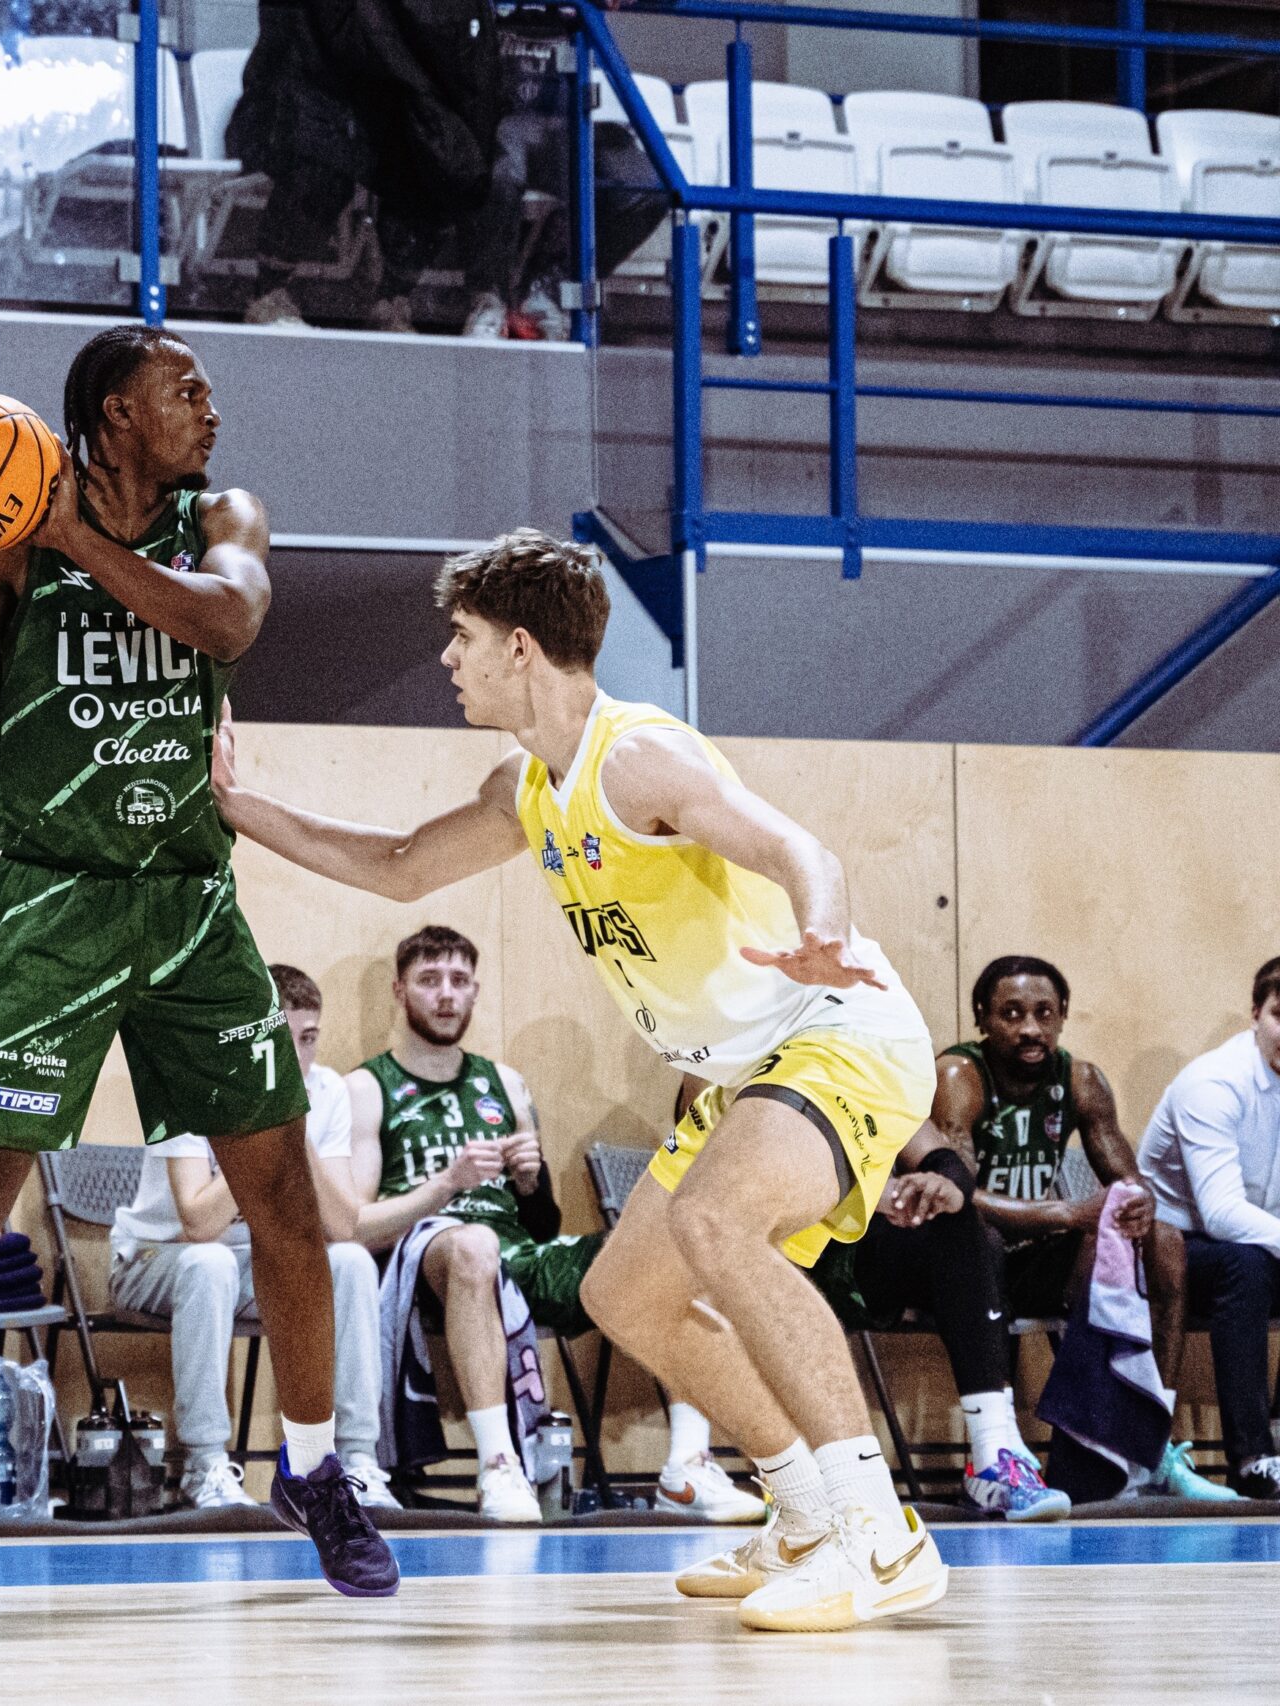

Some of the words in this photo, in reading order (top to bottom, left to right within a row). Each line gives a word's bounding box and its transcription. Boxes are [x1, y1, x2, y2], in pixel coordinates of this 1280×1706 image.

[60, 611, 136, 628] PATR
[57, 627, 199, 686] LEVIC
[108, 695, 202, 721] VEOLIA
[93, 737, 191, 766] Cloetta
[127, 812, 167, 825] ŠEBO
[22, 1052, 68, 1068] Optika
[36, 1067, 66, 1079] MANIA
[440, 1092, 465, 1128] 3
[403, 1145, 464, 1186] LEV
[976, 1163, 1053, 1201] EVIC
